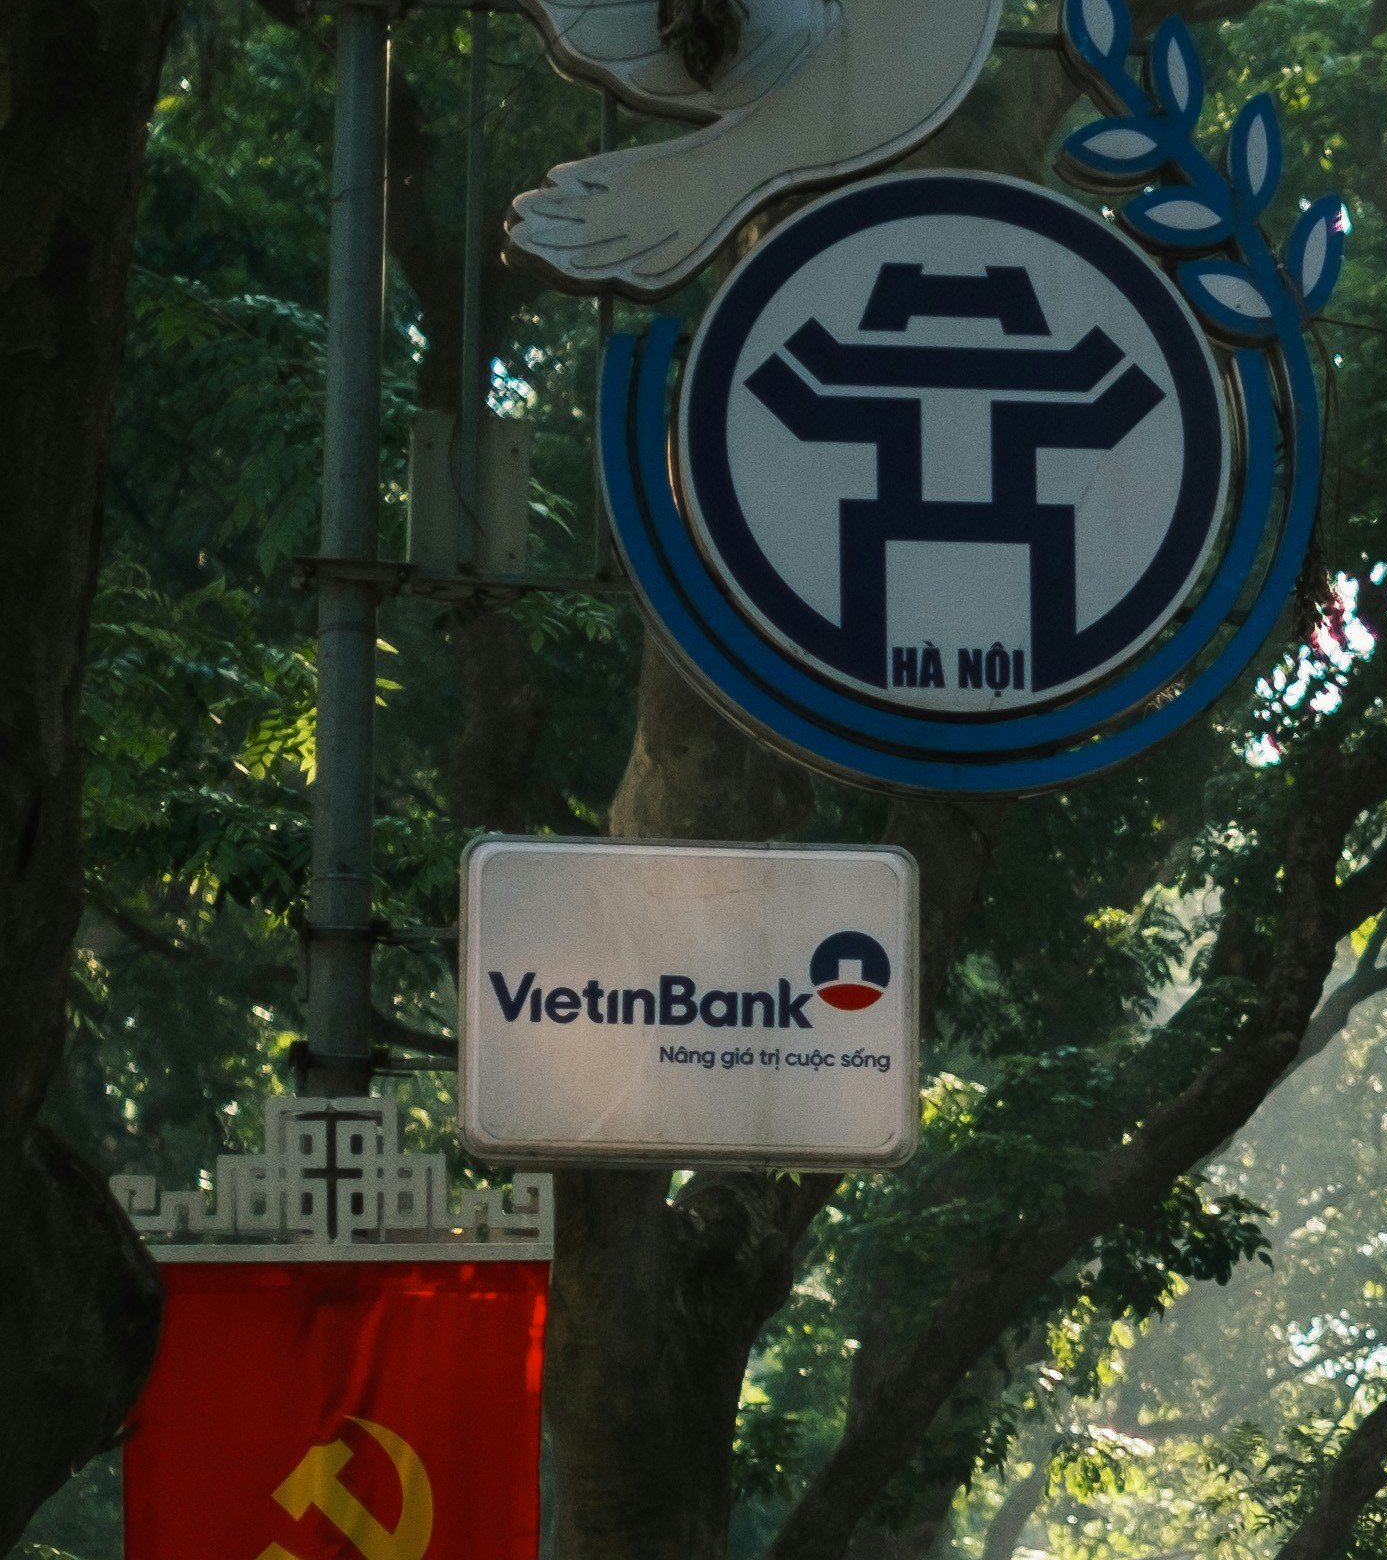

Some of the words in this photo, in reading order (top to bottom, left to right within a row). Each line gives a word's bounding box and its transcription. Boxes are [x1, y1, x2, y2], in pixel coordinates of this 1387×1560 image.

[891, 638, 945, 689] HÀ
[957, 640, 1026, 698] NỘI
[487, 970, 813, 1029] VietinBank
[659, 1044, 716, 1069] Nâng
[720, 1046, 754, 1070] giá
[758, 1047, 781, 1071] trị
[784, 1048, 836, 1071] cuộc
[840, 1047, 892, 1073] sống
